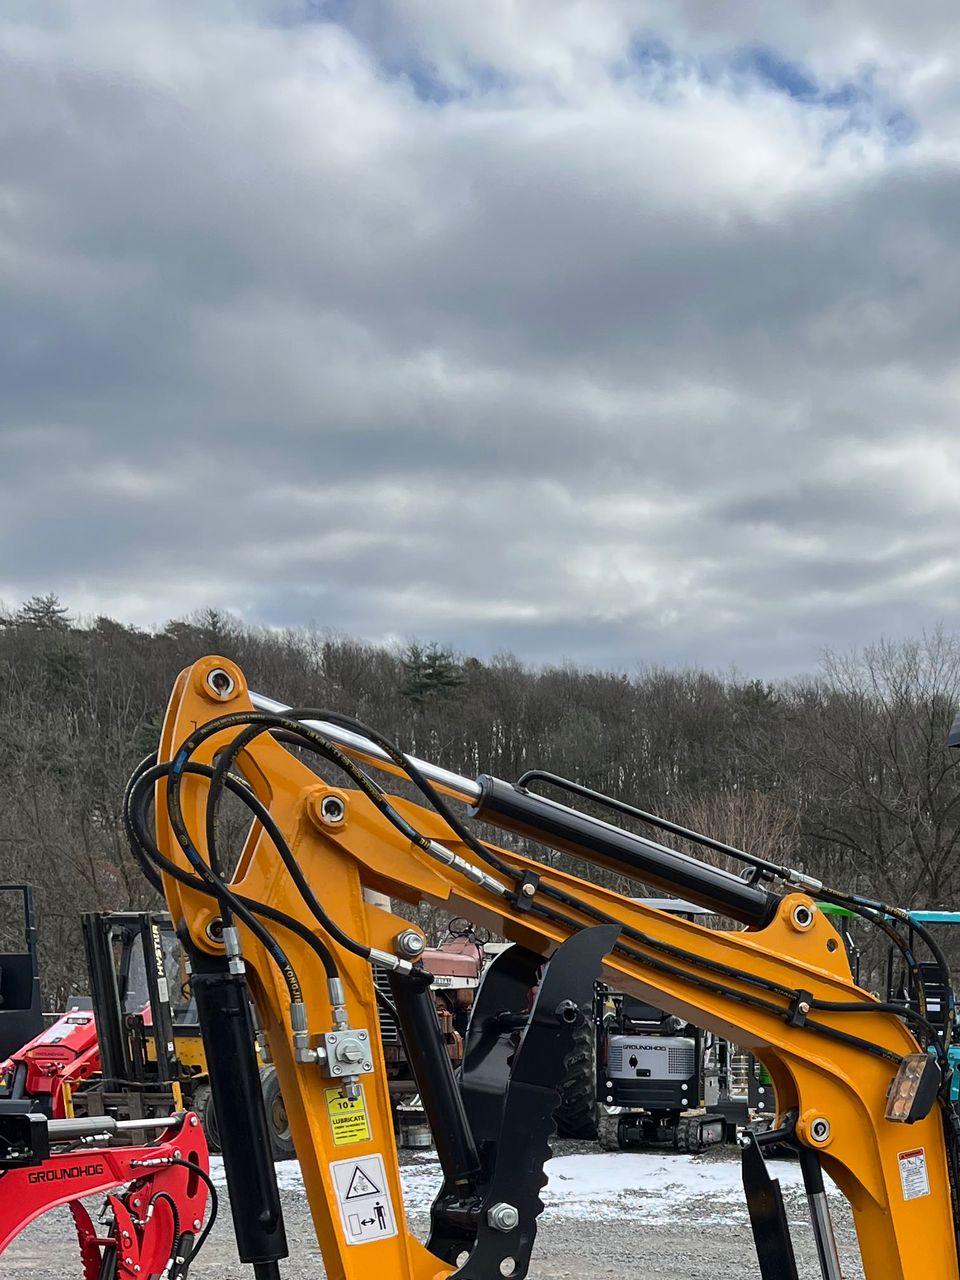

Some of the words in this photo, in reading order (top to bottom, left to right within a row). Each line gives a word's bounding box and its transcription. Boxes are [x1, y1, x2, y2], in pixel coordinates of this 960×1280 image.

[284, 964, 304, 1006] YONGJIE
[332, 1115, 365, 1125] LUBRICATE
[27, 1163, 104, 1184] GROUNDHOG
